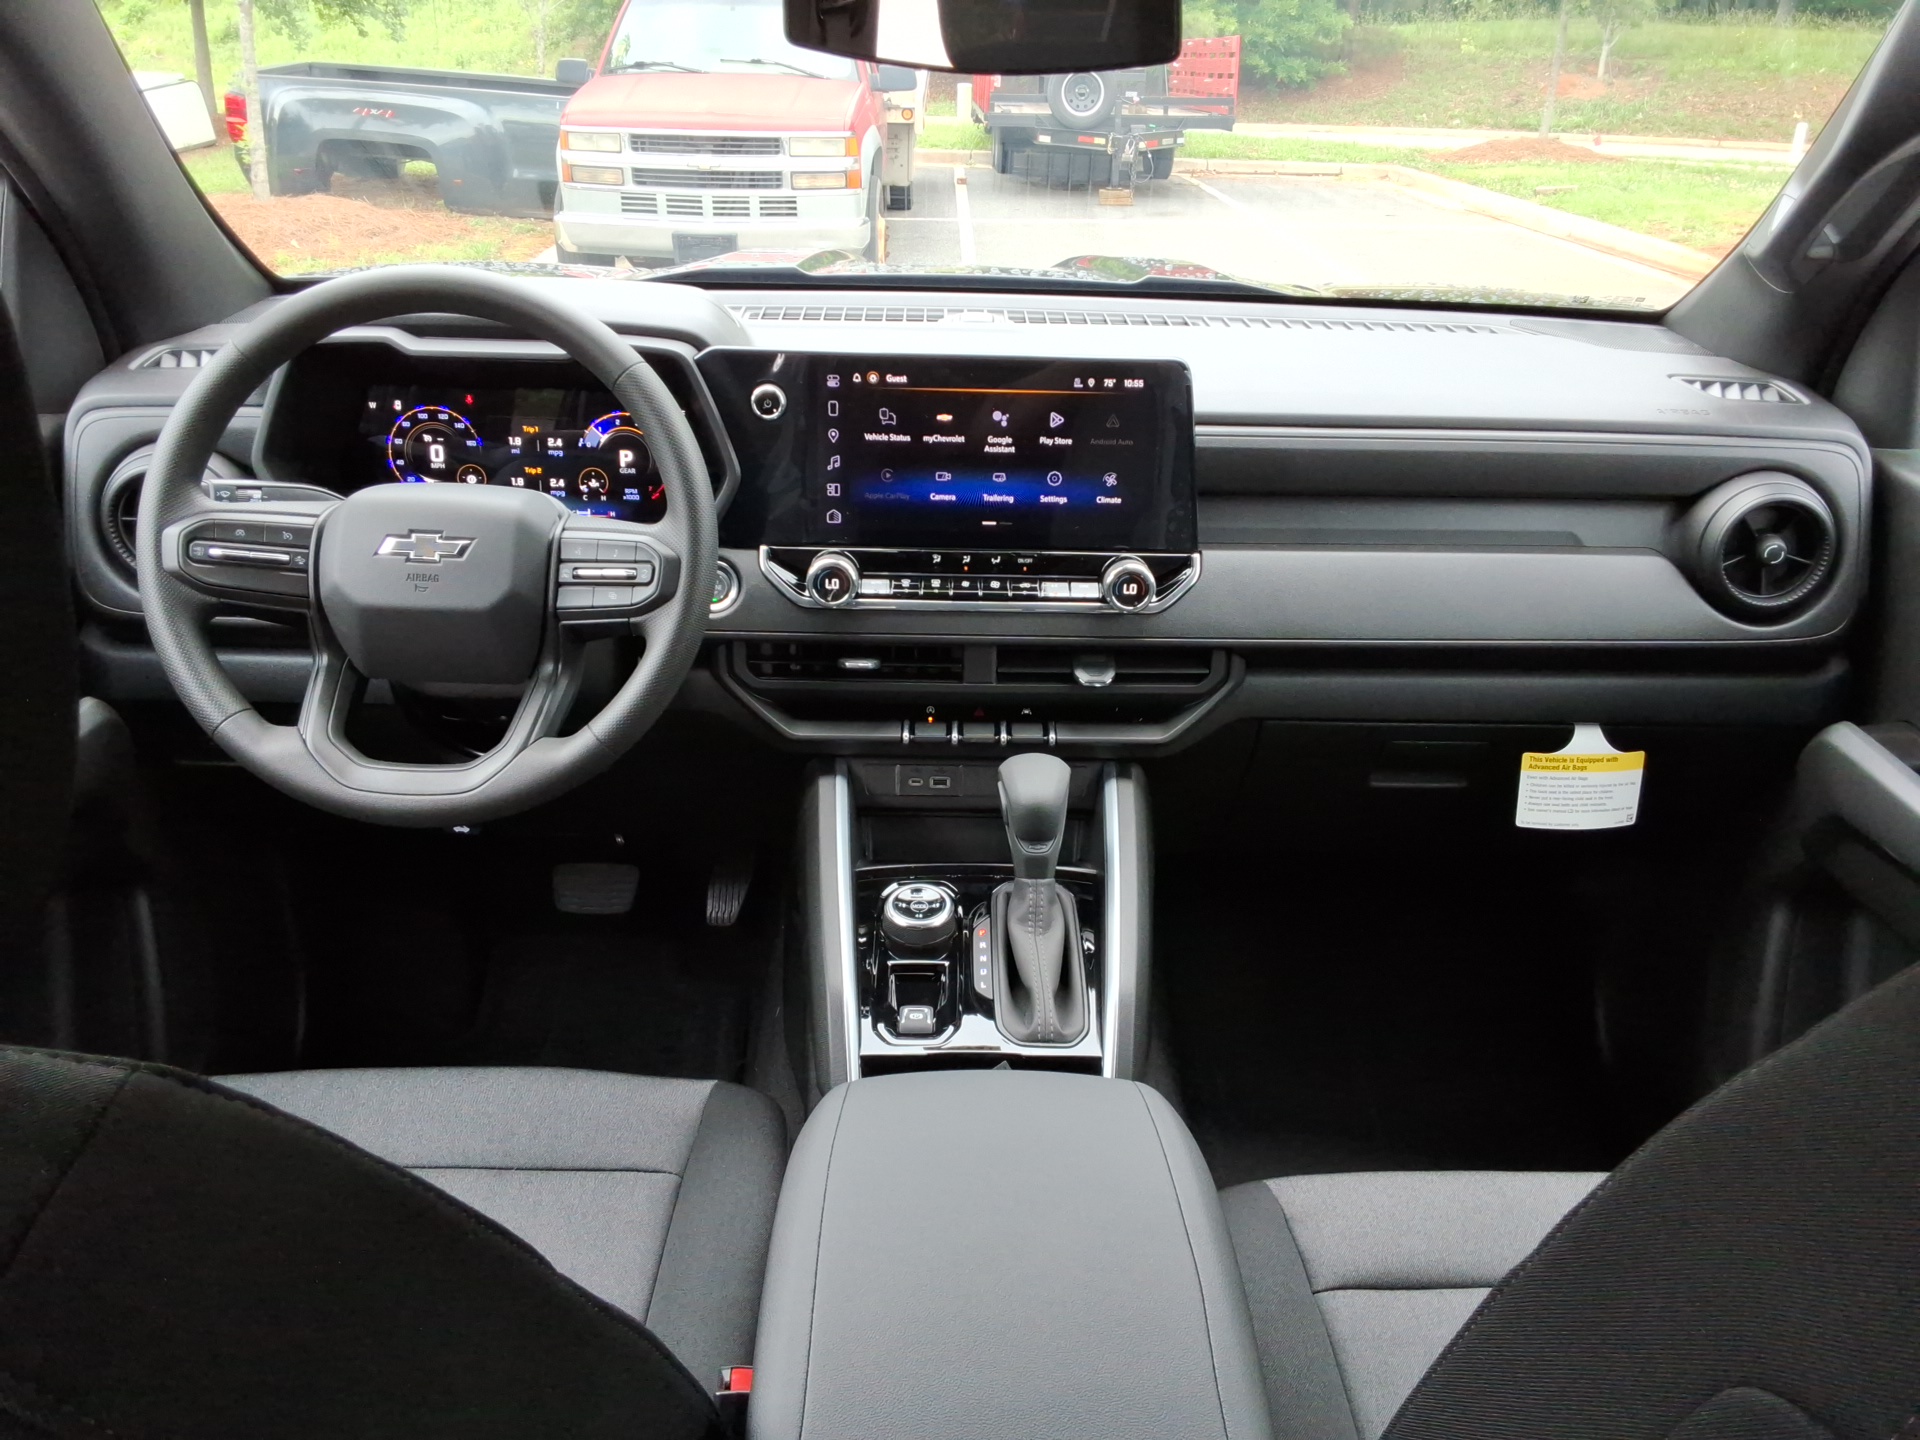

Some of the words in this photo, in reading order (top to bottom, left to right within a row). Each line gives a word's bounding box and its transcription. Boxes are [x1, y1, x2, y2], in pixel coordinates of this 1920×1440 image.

[886, 374, 908, 383] Guest
[1124, 379, 1144, 388] 10:55
[522, 425, 534, 434] Trip
[508, 437, 522, 446] 1.8
[547, 437, 563, 447] 2.4
[864, 433, 889, 441] Vehicle
[889, 433, 911, 442] Status
[923, 434, 965, 444] myChevrolet
[987, 435, 1013, 445] Google
[1039, 436, 1054, 446] Play
[1054, 437, 1073, 445] Store
[430, 444, 444, 462] 0
[548, 449, 564, 457] mpg
[984, 445, 1015, 453] Assistant
[619, 449, 634, 467] P
[524, 466, 536, 475] Trip
[511, 477, 525, 487] 1.8
[550, 478, 565, 487] 2.4
[550, 489, 566, 497] mpg
[930, 493, 956, 501] Camera
[983, 493, 1014, 504] Trailering
[1040, 495, 1068, 505] Settings
[1096, 496, 1122, 504] Climate
[406, 573, 440, 582] AIRBAG
[825, 578, 840, 590] LO
[1123, 584, 1138, 595] LO
[1528, 763, 1560, 771] Advanced
